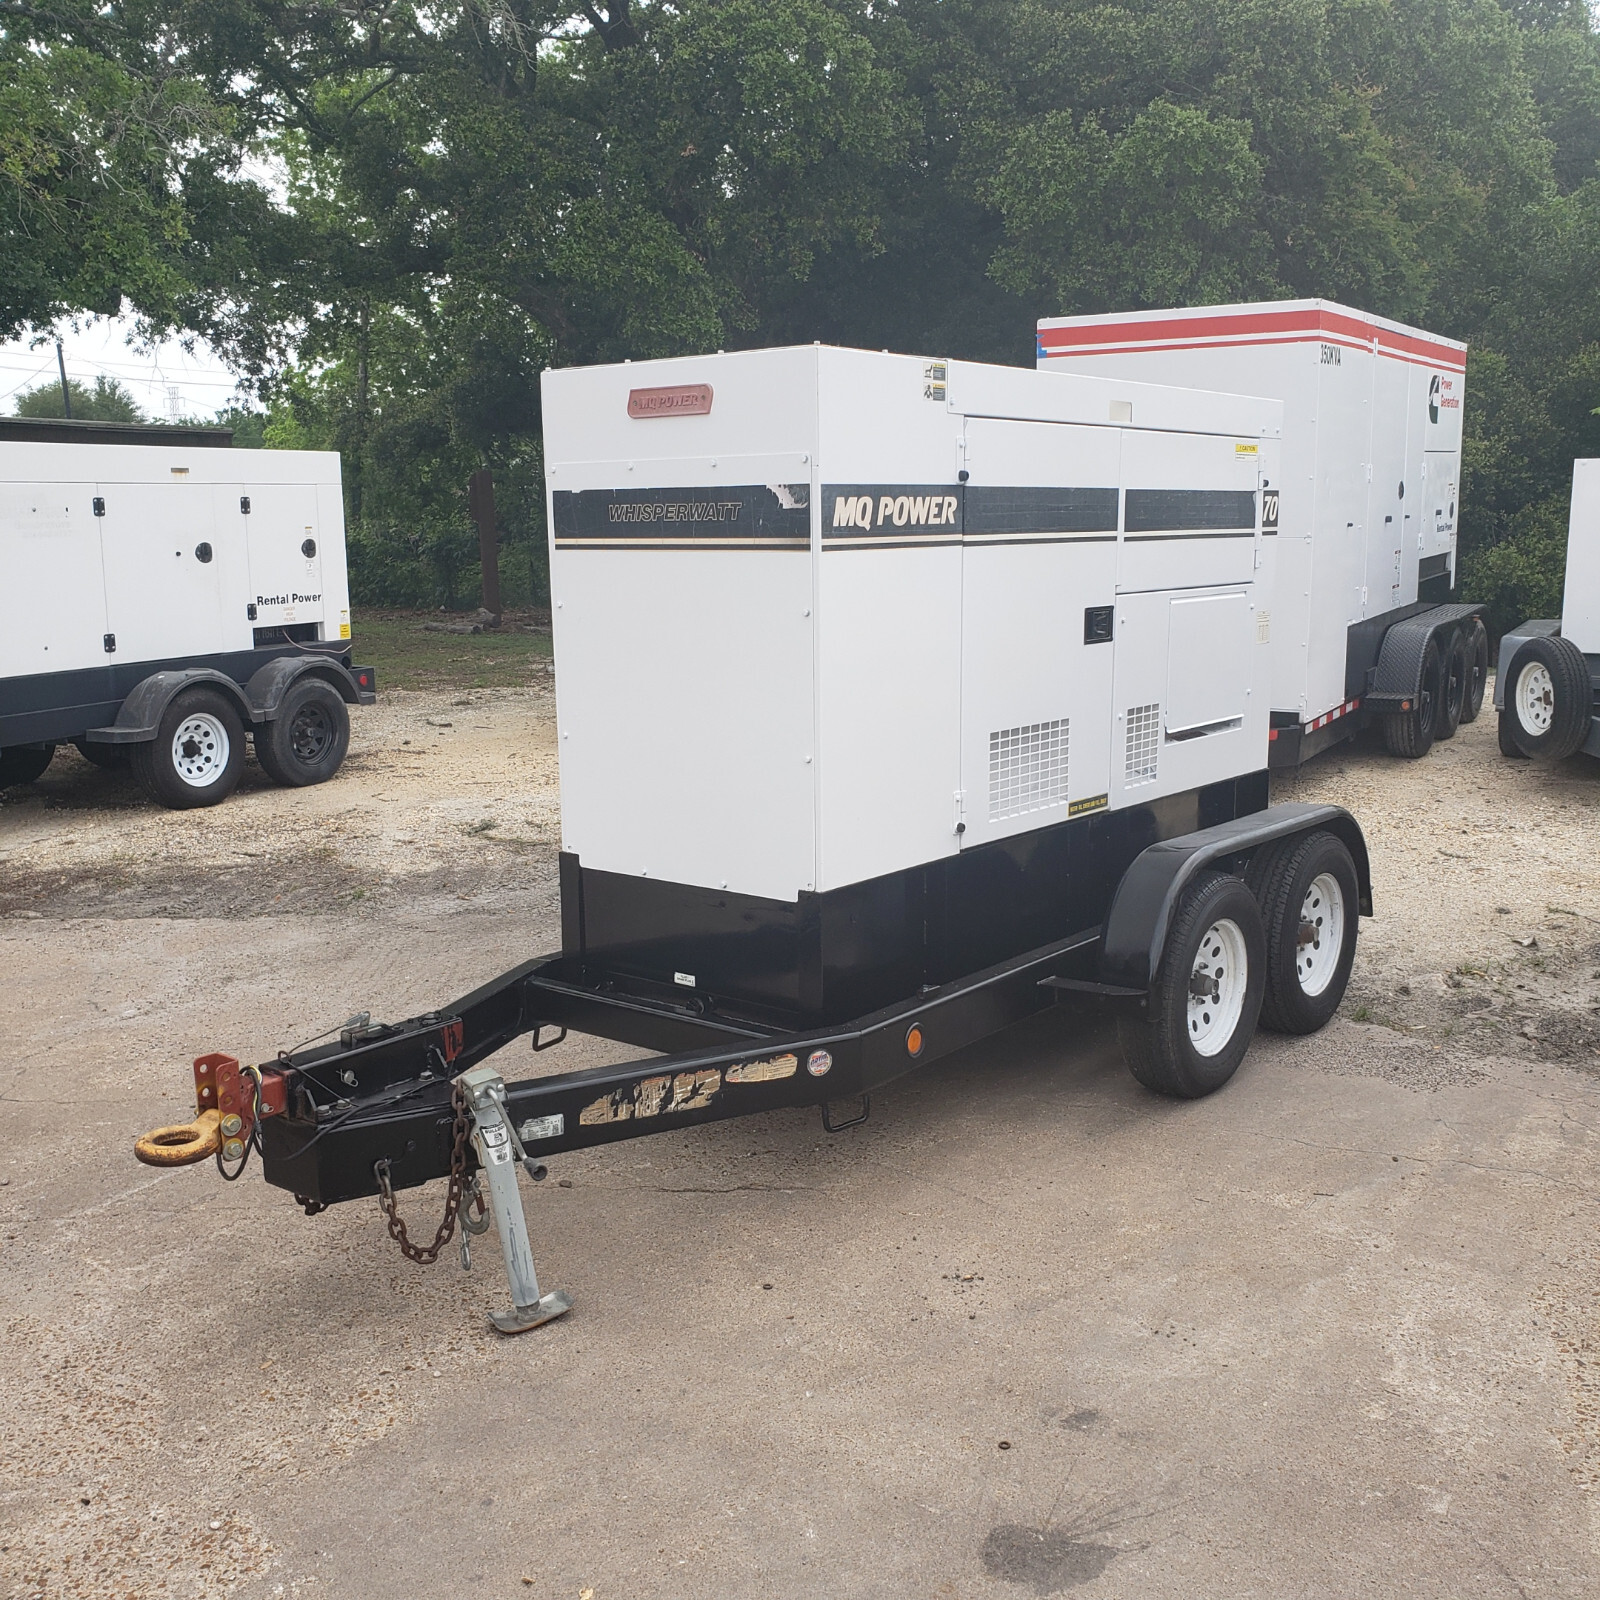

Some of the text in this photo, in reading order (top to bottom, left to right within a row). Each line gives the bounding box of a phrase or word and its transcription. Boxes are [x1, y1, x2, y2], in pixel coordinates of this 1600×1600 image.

[639, 393, 699, 411] MQ POWER
[608, 502, 743, 522] WHISPERWATT
[832, 496, 958, 531] MQ POWER
[1262, 495, 1278, 522] 70
[256, 593, 322, 607] Rental Power
